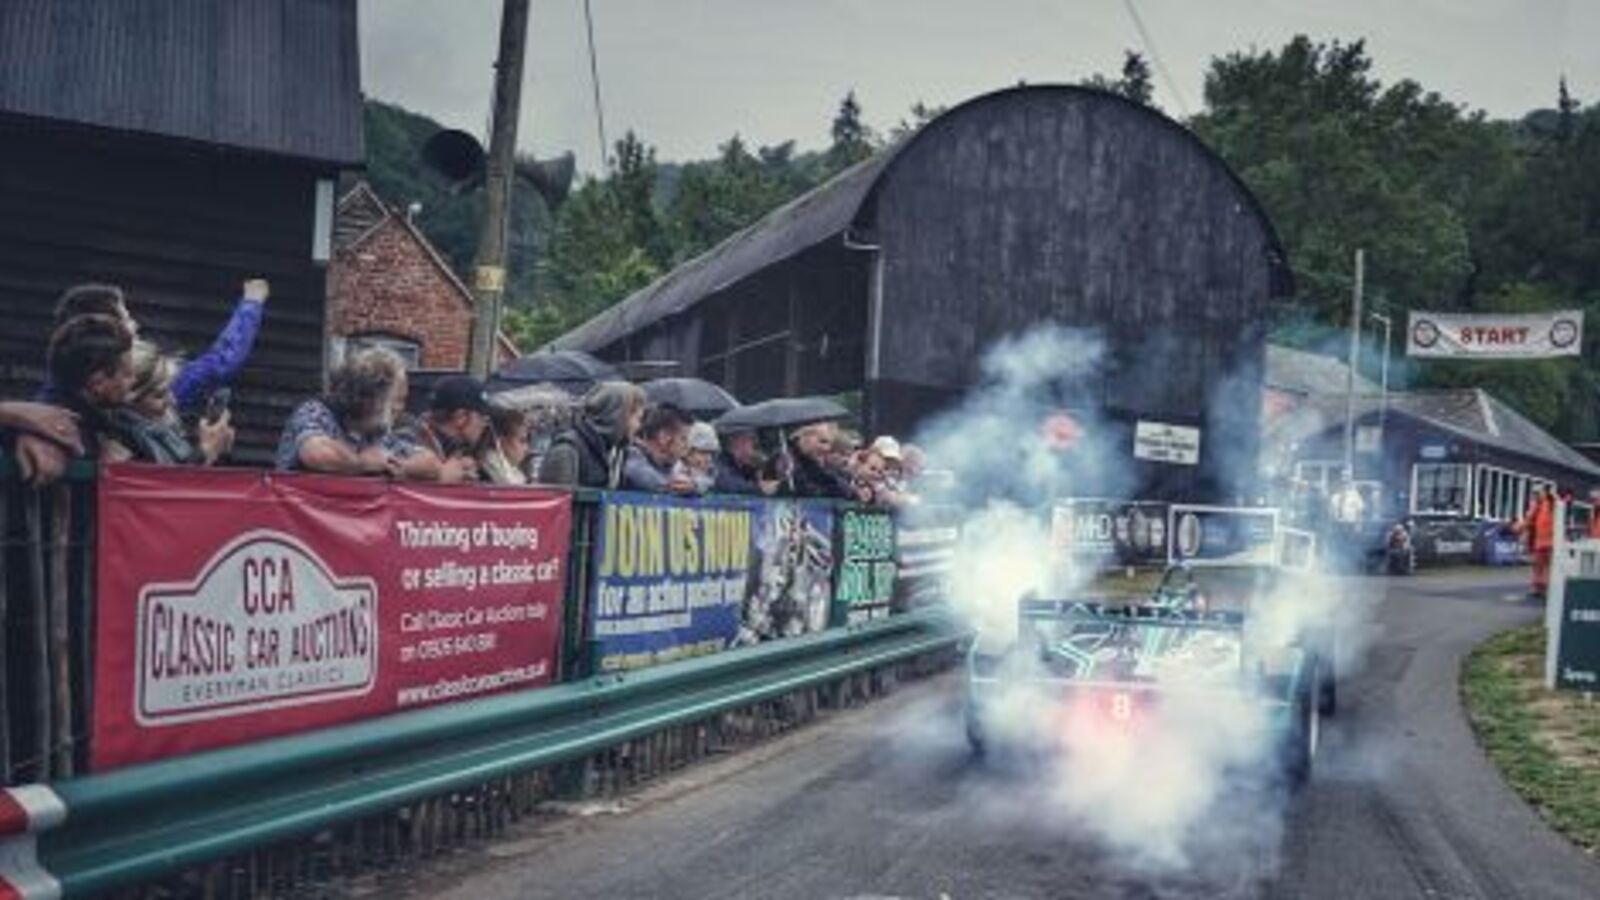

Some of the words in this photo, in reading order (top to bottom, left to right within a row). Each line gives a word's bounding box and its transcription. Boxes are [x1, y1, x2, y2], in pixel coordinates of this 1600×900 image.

[1460, 327, 1530, 345] START
[397, 521, 470, 552] Thinking
[490, 521, 538, 550] buying
[599, 504, 664, 577] JOIN
[669, 507, 699, 575] US
[703, 510, 749, 575] NOW
[243, 557, 294, 615] CCA
[402, 568, 420, 590] or
[424, 561, 476, 591] selling
[479, 565, 490, 584] a
[492, 559, 534, 584] classic
[598, 581, 623, 616] for
[152, 603, 235, 679] CLASSIC
[247, 628, 280, 670] CAR
[291, 597, 368, 665] AUCTIONS
[182, 674, 270, 702] EVERYMAN
